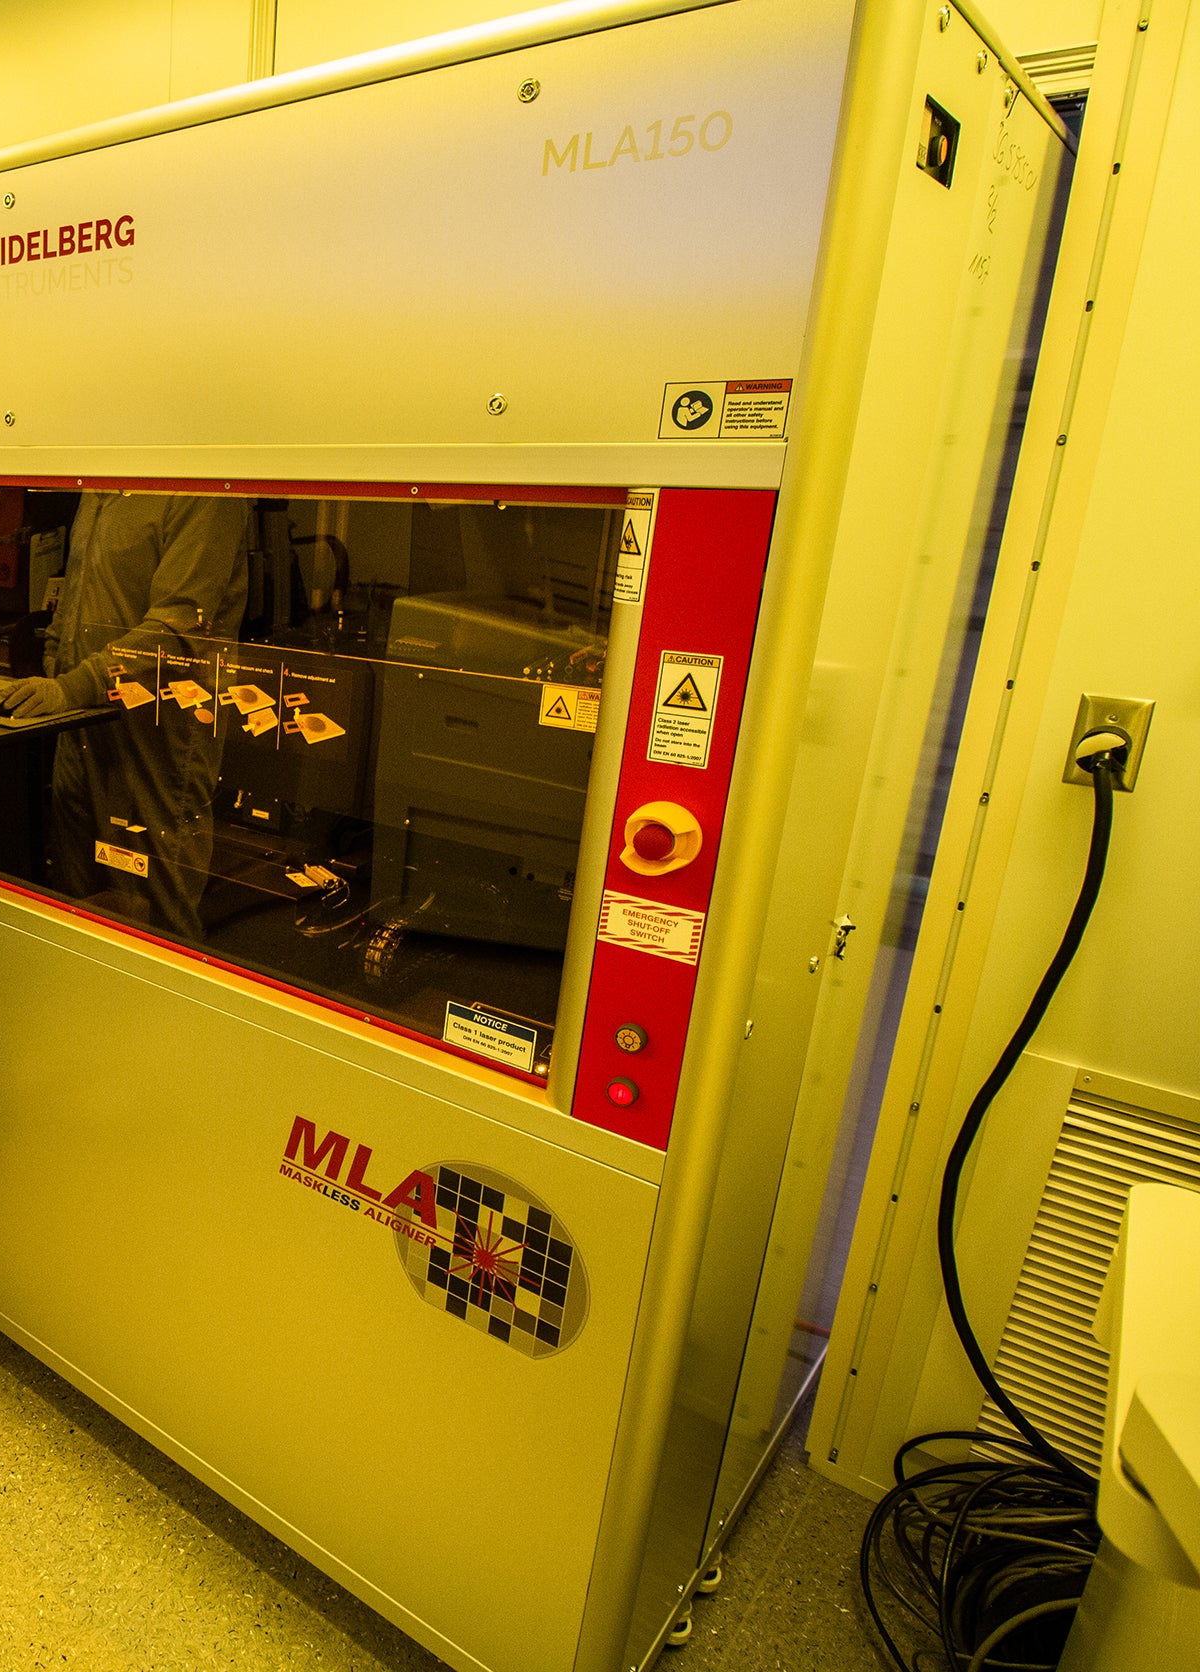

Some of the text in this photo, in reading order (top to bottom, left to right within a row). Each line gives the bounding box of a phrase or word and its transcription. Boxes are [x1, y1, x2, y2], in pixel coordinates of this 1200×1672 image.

[542, 110, 734, 177] MLA150
[675, 656, 714, 666] CAUTION
[622, 908, 679, 928] EMERGENCY
[627, 919, 671, 934] SHUT-OFF
[630, 929, 665, 943] SWITCH
[473, 1014, 508, 1032] NOTICE
[453, 1022, 472, 1034] Class
[480, 1031, 497, 1042] laser
[498, 1039, 526, 1053] product
[284, 1115, 437, 1230] MLA
[279, 1164, 437, 1249] MASKLESS ALIGNER
